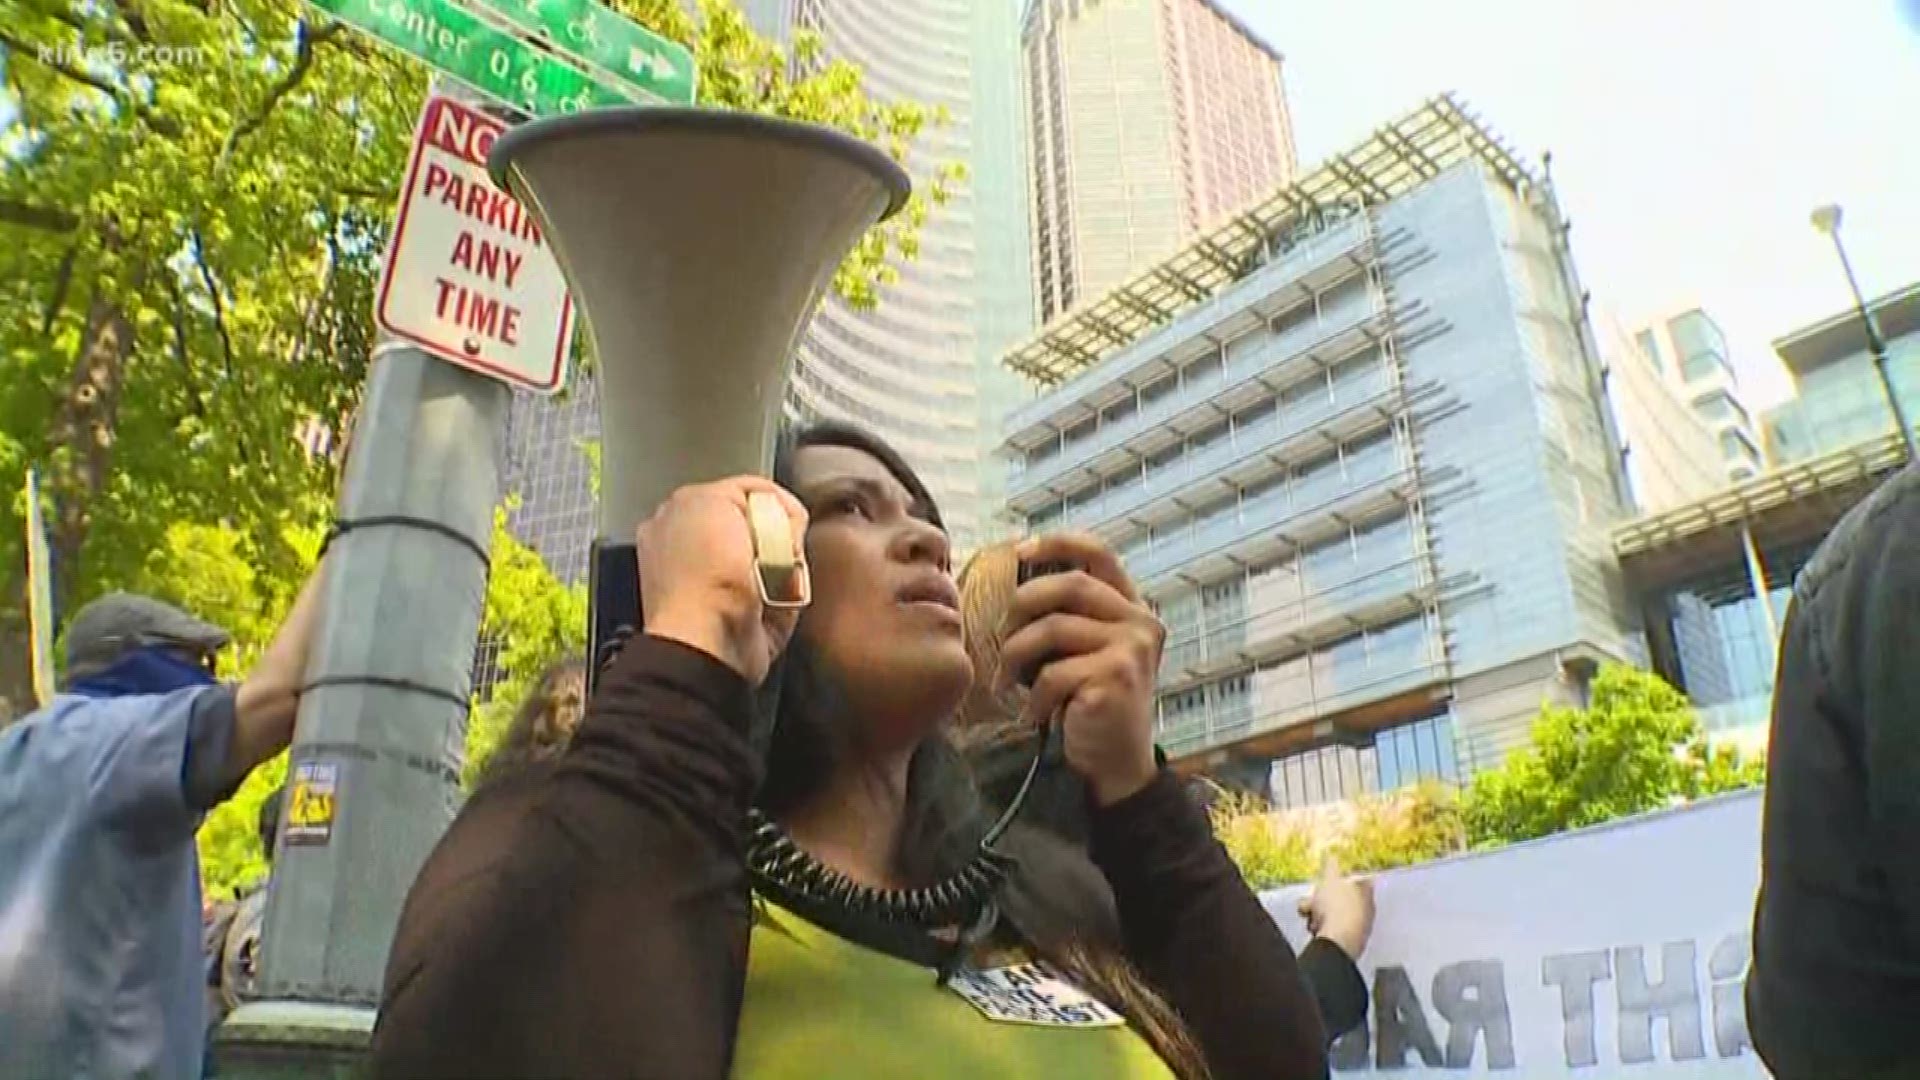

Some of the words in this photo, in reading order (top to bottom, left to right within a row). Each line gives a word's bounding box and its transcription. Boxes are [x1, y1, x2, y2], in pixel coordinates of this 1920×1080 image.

[490, 49, 538, 94] 0.6
[424, 163, 542, 246] PARKIN
[451, 231, 522, 288] ANY
[433, 277, 521, 346] TIME
